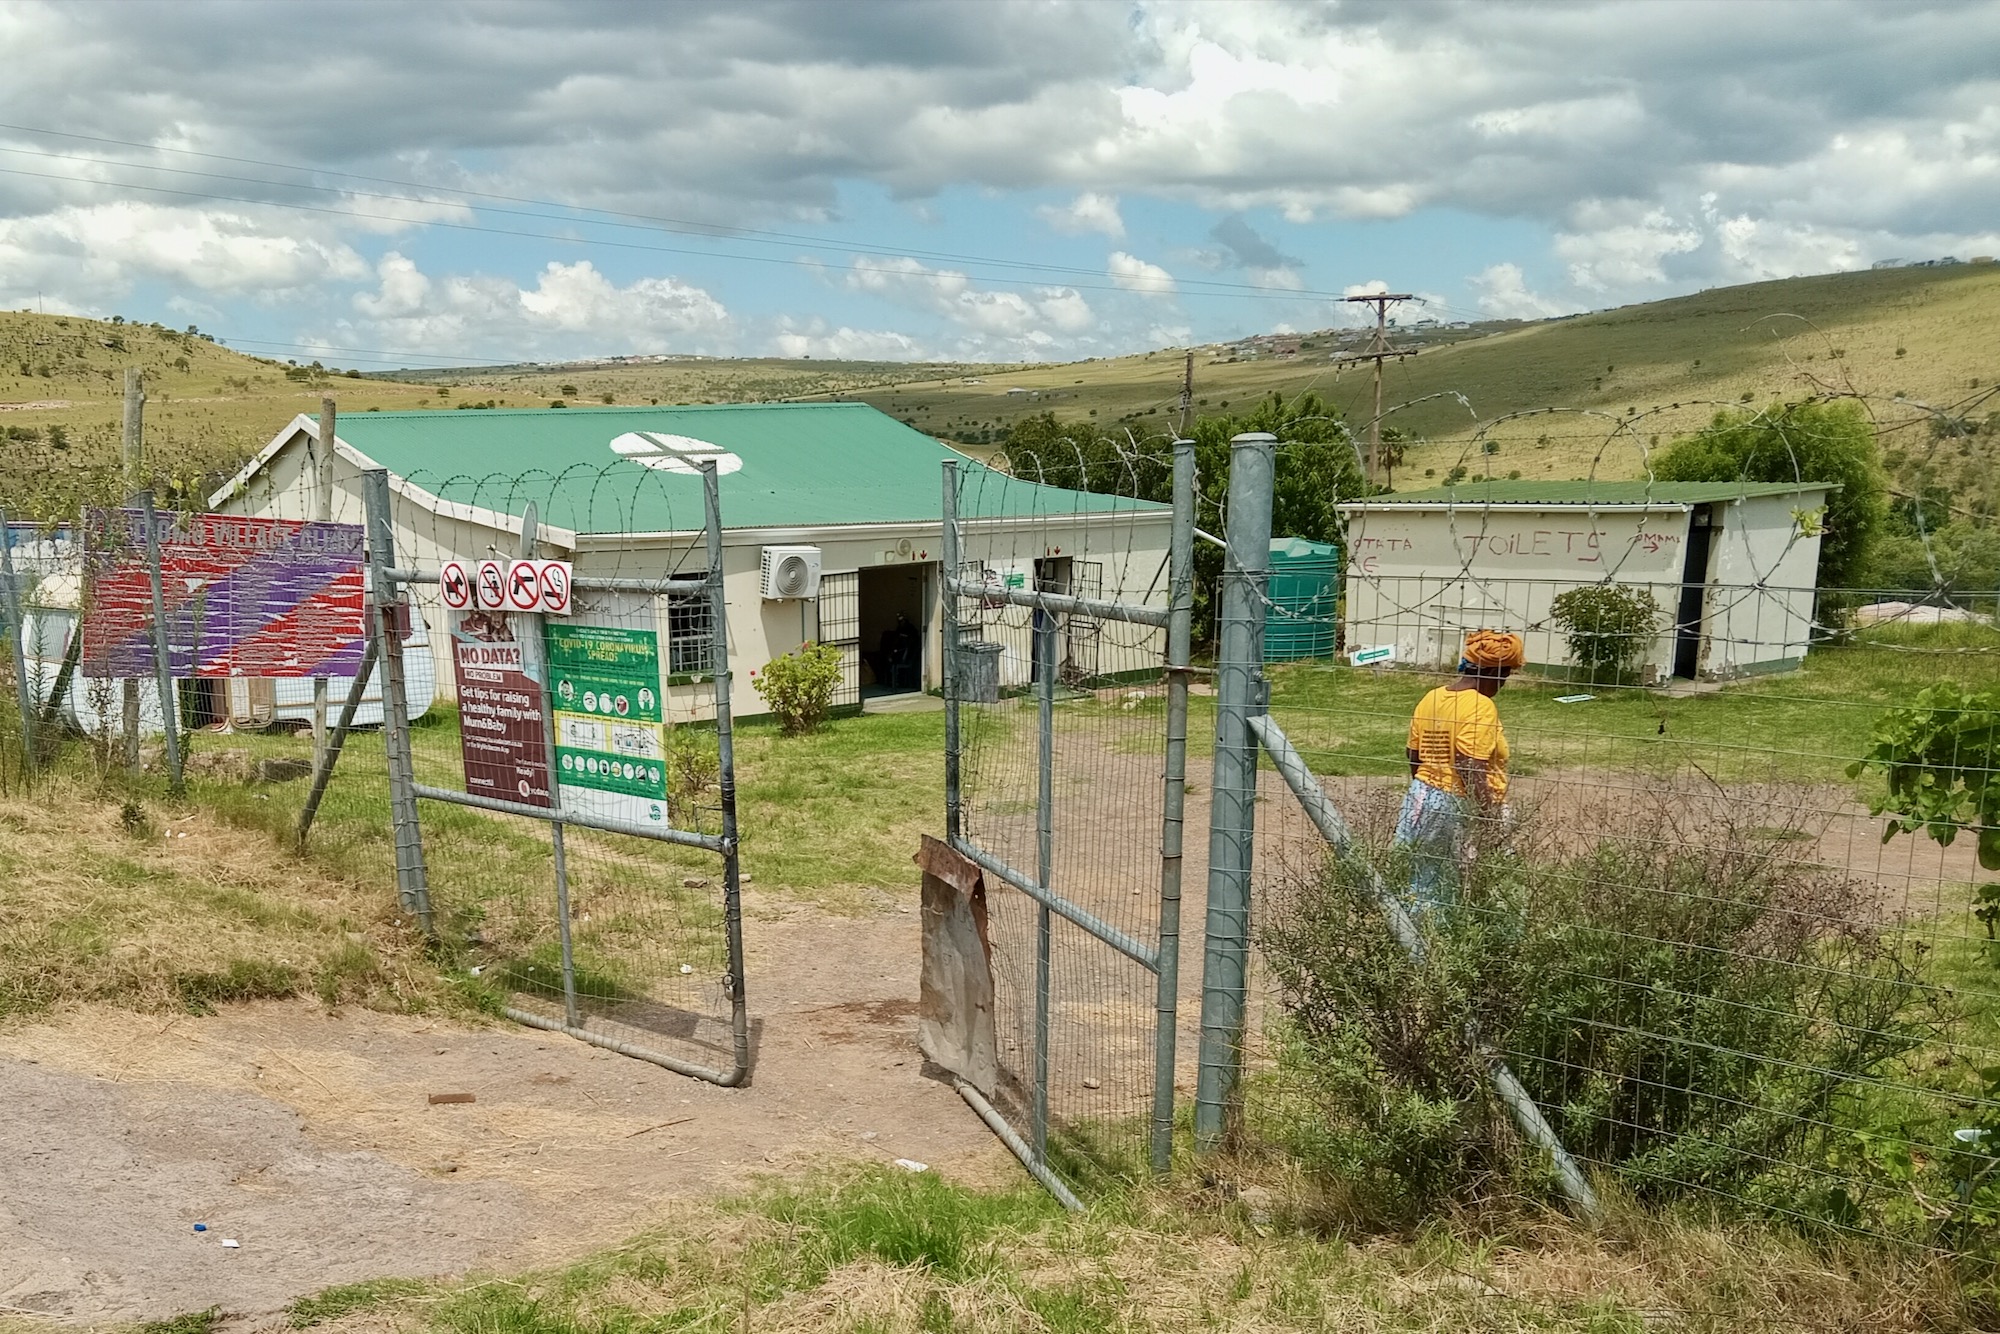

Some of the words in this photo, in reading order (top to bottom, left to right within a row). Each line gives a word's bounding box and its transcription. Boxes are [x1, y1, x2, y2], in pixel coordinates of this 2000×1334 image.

[560, 638, 593, 650] COVID-19
[596, 641, 650, 655] CORONAVIRUS
[460, 648, 479, 664] NO
[480, 648, 520, 664] DATA?
[588, 650, 618, 662] SPREADS
[466, 670, 475, 678] NO
[475, 671, 501, 681] PROBLEM
[460, 685, 474, 697] Get
[475, 688, 489, 701] tips
[489, 689, 500, 700] for
[502, 691, 530, 707] raising
[462, 703, 467, 711] a
[467, 701, 496, 718] healthy
[496, 705, 522, 721] family
[522, 709, 542, 721] with
[463, 715, 507, 734] Mum&Baby
